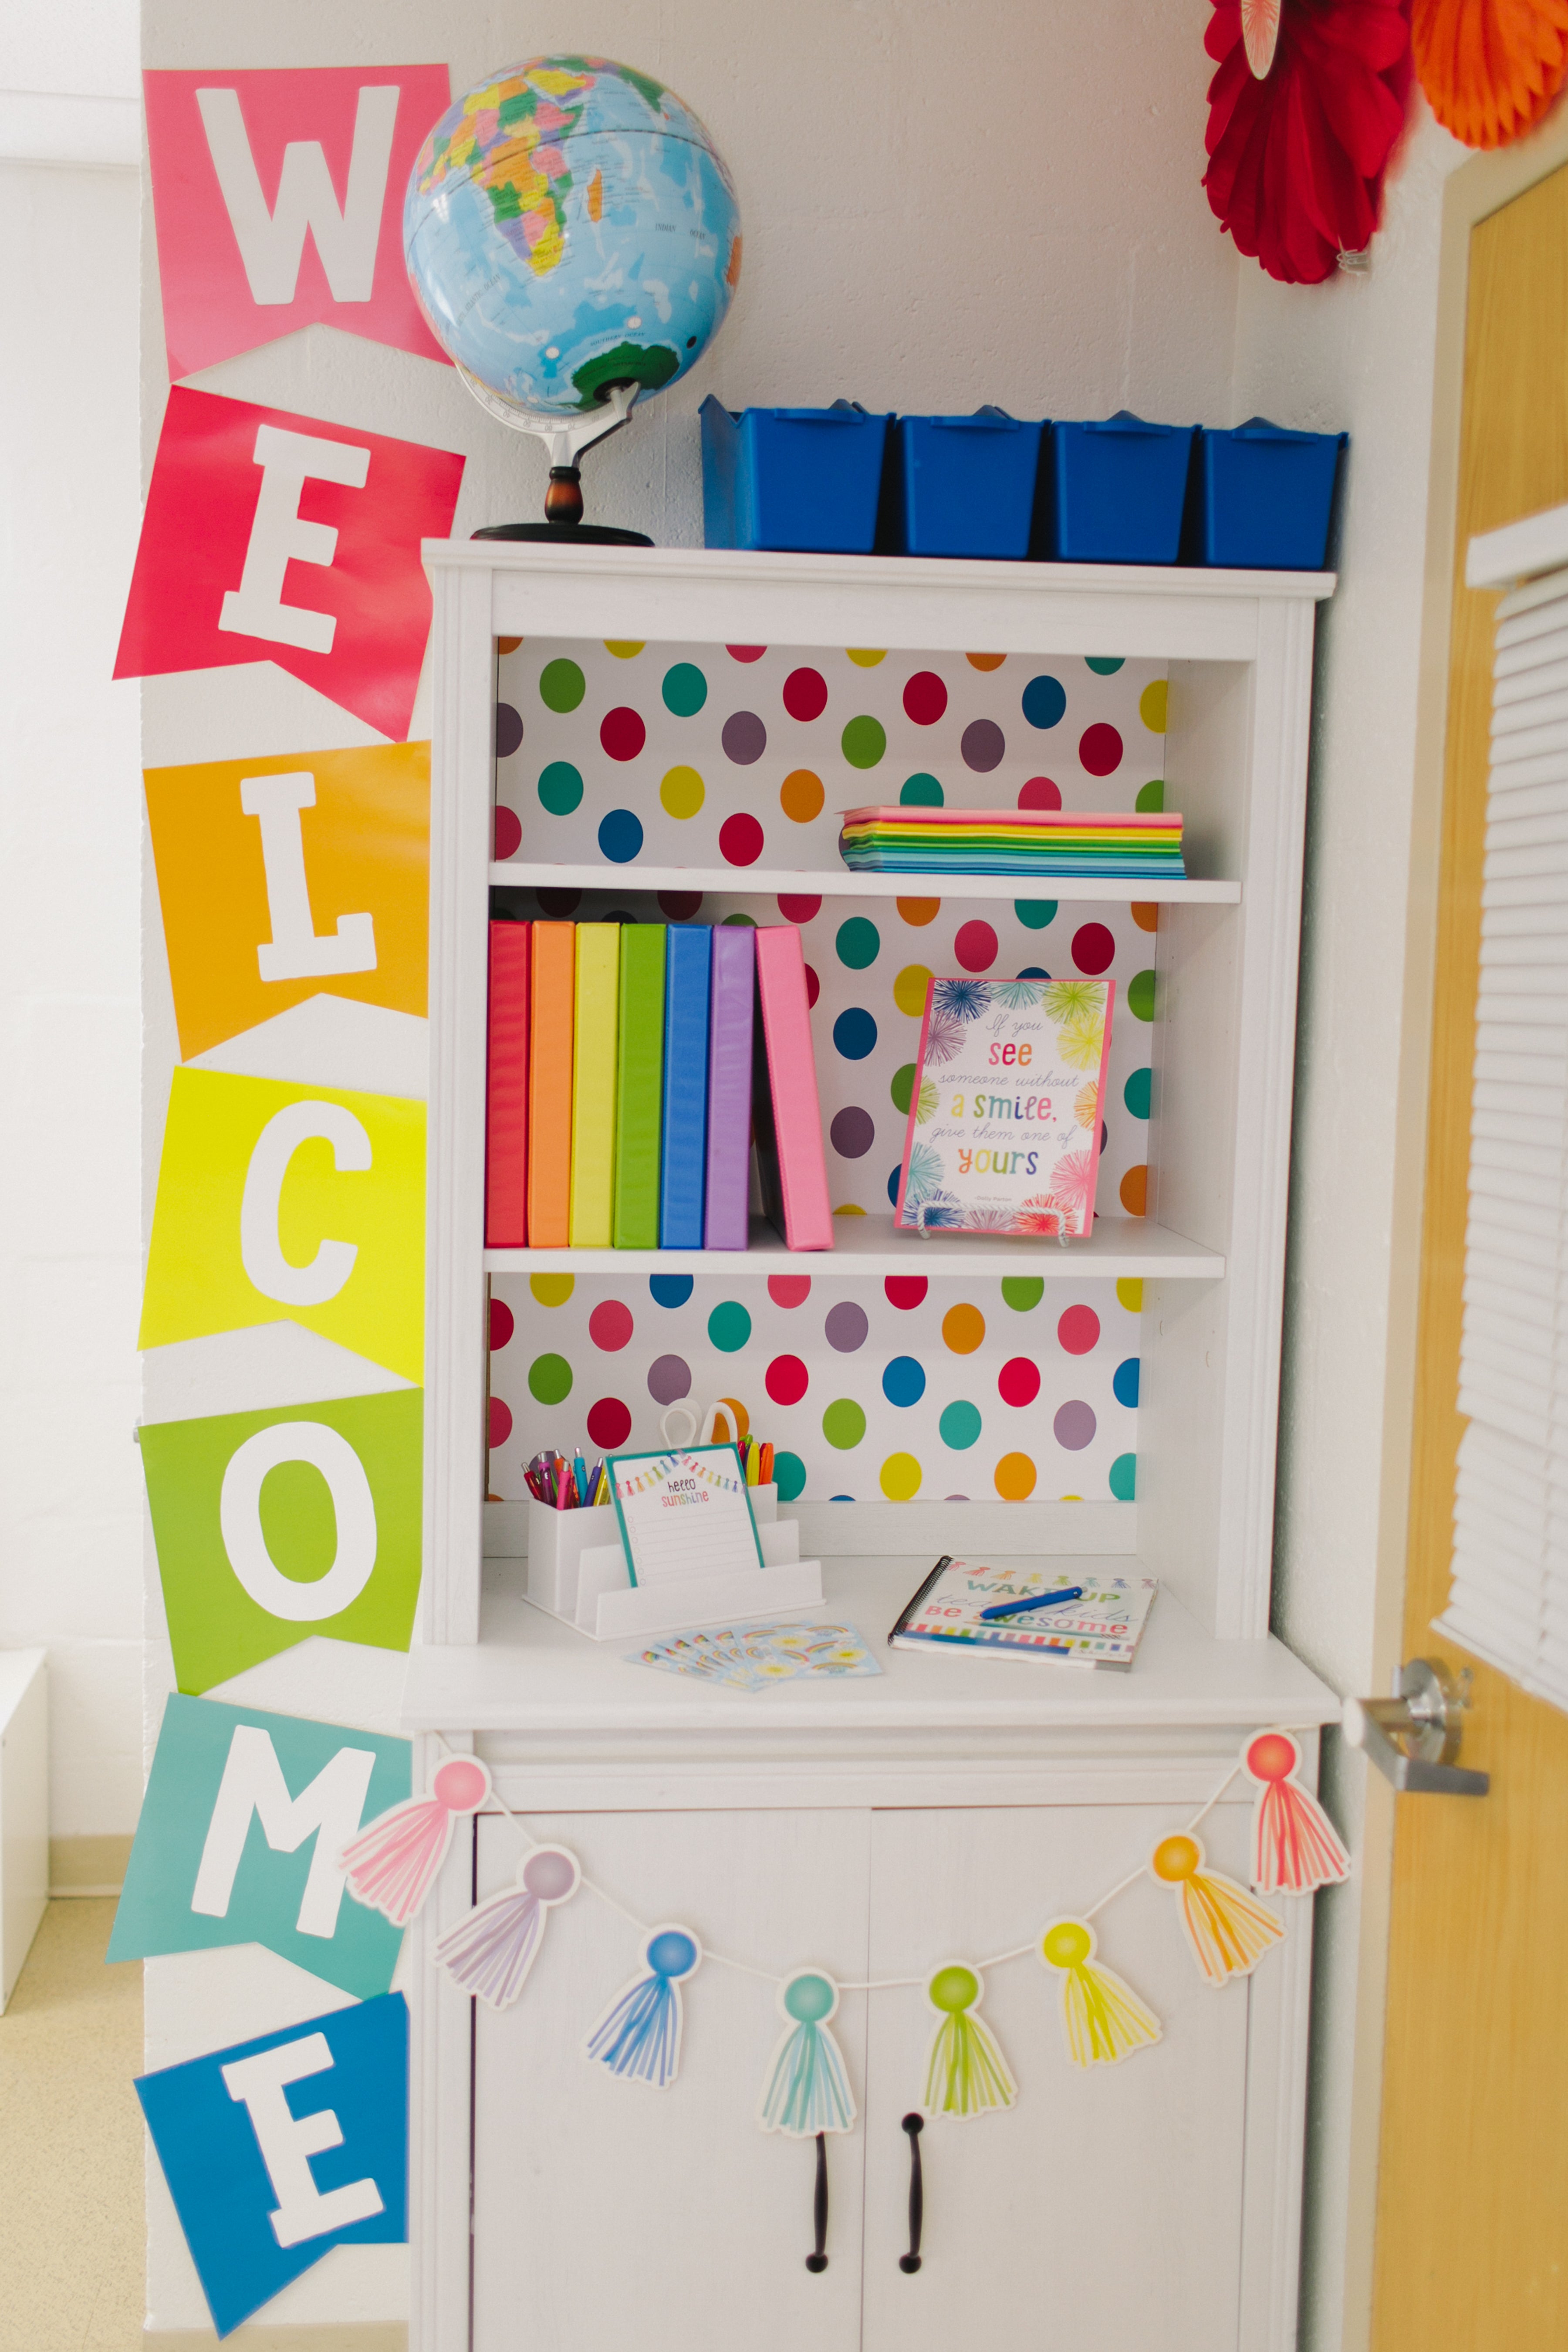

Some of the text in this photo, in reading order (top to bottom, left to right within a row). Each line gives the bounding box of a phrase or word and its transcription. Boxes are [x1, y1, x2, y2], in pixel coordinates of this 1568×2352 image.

[655, 223, 676, 232] INDIAN
[590, 334, 621, 346] SOUTHERN
[986, 1014, 1044, 1037] If you
[988, 1042, 1032, 1066] see
[938, 1070, 1080, 1087] someone without
[951, 1094, 1057, 1122] a smile,
[929, 1122, 1078, 1149] give them one of
[191, 85, 400, 2248] WELCOME
[958, 1149, 1039, 1175] yours
[667, 1479, 696, 1493] hello
[661, 1490, 710, 1507] sunshine
[1075, 1592, 1121, 1603] UP
[1050, 1604, 1139, 1622] kids
